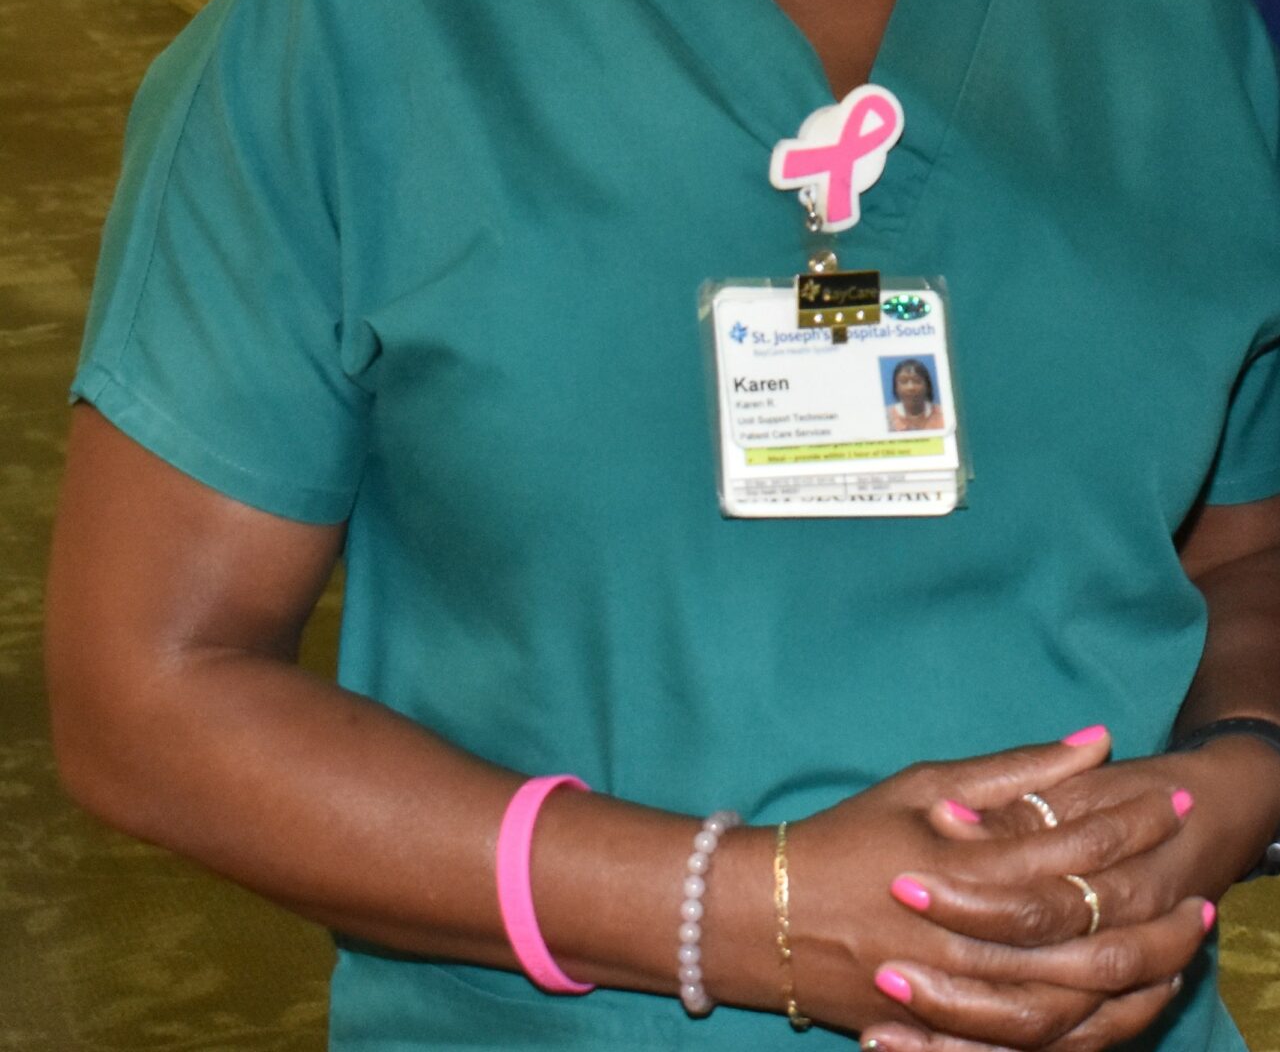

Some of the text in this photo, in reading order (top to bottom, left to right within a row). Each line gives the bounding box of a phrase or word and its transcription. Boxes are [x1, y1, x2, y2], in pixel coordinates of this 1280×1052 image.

[752, 323, 936, 346] St. Joseph's ospital-South
[733, 376, 790, 393] Karen
